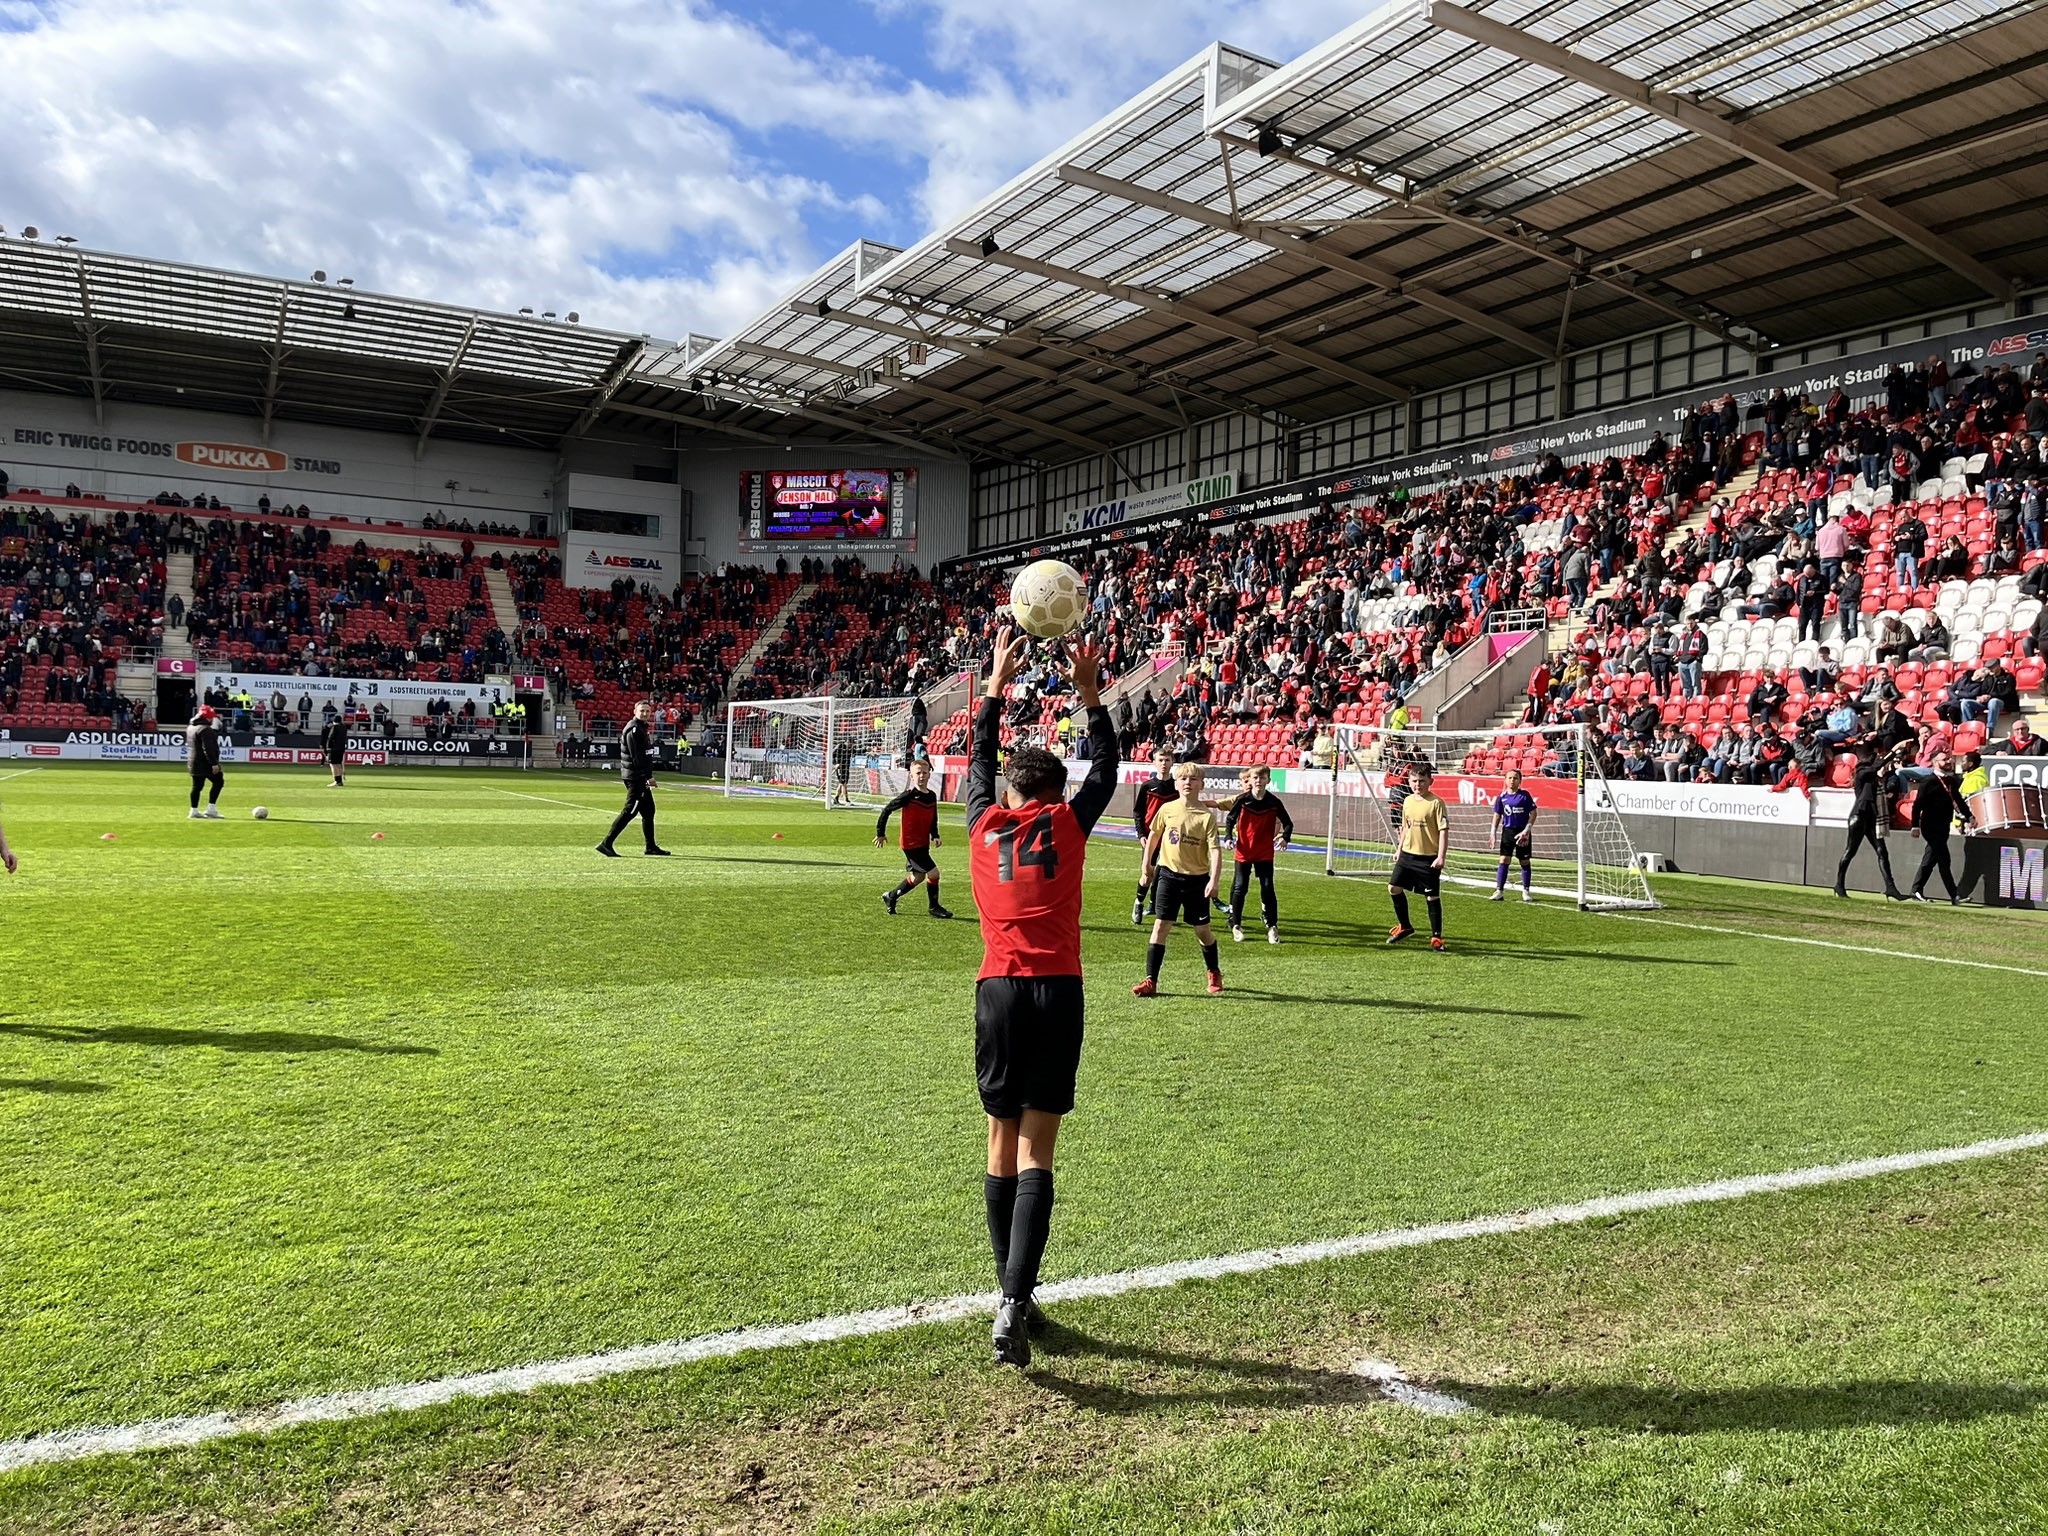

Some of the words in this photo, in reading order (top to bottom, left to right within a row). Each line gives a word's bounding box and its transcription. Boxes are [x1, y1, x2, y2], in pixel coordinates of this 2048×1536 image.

[1952, 347, 1984, 363] The
[1673, 405, 1689, 421] Th
[1805, 375, 1840, 393] York
[1844, 361, 1914, 386] Stadim
[1471, 452, 1489, 464] The
[1490, 438, 1539, 461] AESSEAL
[1540, 436, 1564, 450] New
[1567, 428, 1592, 443] York
[1595, 417, 1646, 438] Stadium
[14, 428, 54, 446] ERIC
[58, 432, 113, 452] TWIGG
[117, 438, 173, 458] FOODS
[192, 444, 271, 469] PUKKA
[293, 457, 342, 475] STAND
[787, 475, 828, 488] MASCOT
[1318, 486, 1332, 496] The
[1333, 474, 1371, 493] AESSEAL
[1371, 474, 1390, 486] New
[1392, 467, 1411, 481] York
[1413, 459, 1451, 477] Stadium
[778, 490, 812, 503] JENSON
[814, 490, 836, 502] HALL
[892, 471, 905, 538] PINDERS
[1082, 500, 1126, 530] KCM
[1128, 501, 1145, 510] waste
[1146, 492, 1182, 506] management
[1186, 474, 1232, 506] STAND
[750, 474, 761, 539] PINDERS
[1197, 512, 1209, 522] The
[1240, 502, 1255, 513] New
[1256, 498, 1271, 509] York
[1273, 492, 1303, 505] Stadium
[1101, 533, 1111, 542] The
[1135, 525, 1147, 535] New
[1148, 521, 1161, 532] York
[1162, 518, 1183, 529] Stadiu
[837, 543, 897, 551] thinkpinders.com
[1050, 543, 1060, 552] New
[1060, 541, 1071, 550] York
[1071, 537, 1092, 548] Stadium
[603, 555, 663, 571] AESSEAL
[170, 660, 183, 673] G
[254, 680, 338, 692] ASDSTREETLIGHTING.COM
[389, 686, 466, 697] ASDSTREETLIGHTING.COM
[523, 677, 533, 688] H
[66, 731, 232, 747] ASDLIGHTING.M
[346, 738, 470, 753] DLIGHTING.COM
[101, 745, 158, 754] SteelPhalt
[252, 751, 290, 760] MEARS
[301, 752, 323, 760] MEA
[347, 753, 383, 762] MEARS
[1616, 793, 1676, 811] Chamber
[1680, 797, 1695, 812] of
[1699, 797, 1779, 817] Commerce
[984, 812, 1059, 883] 14
